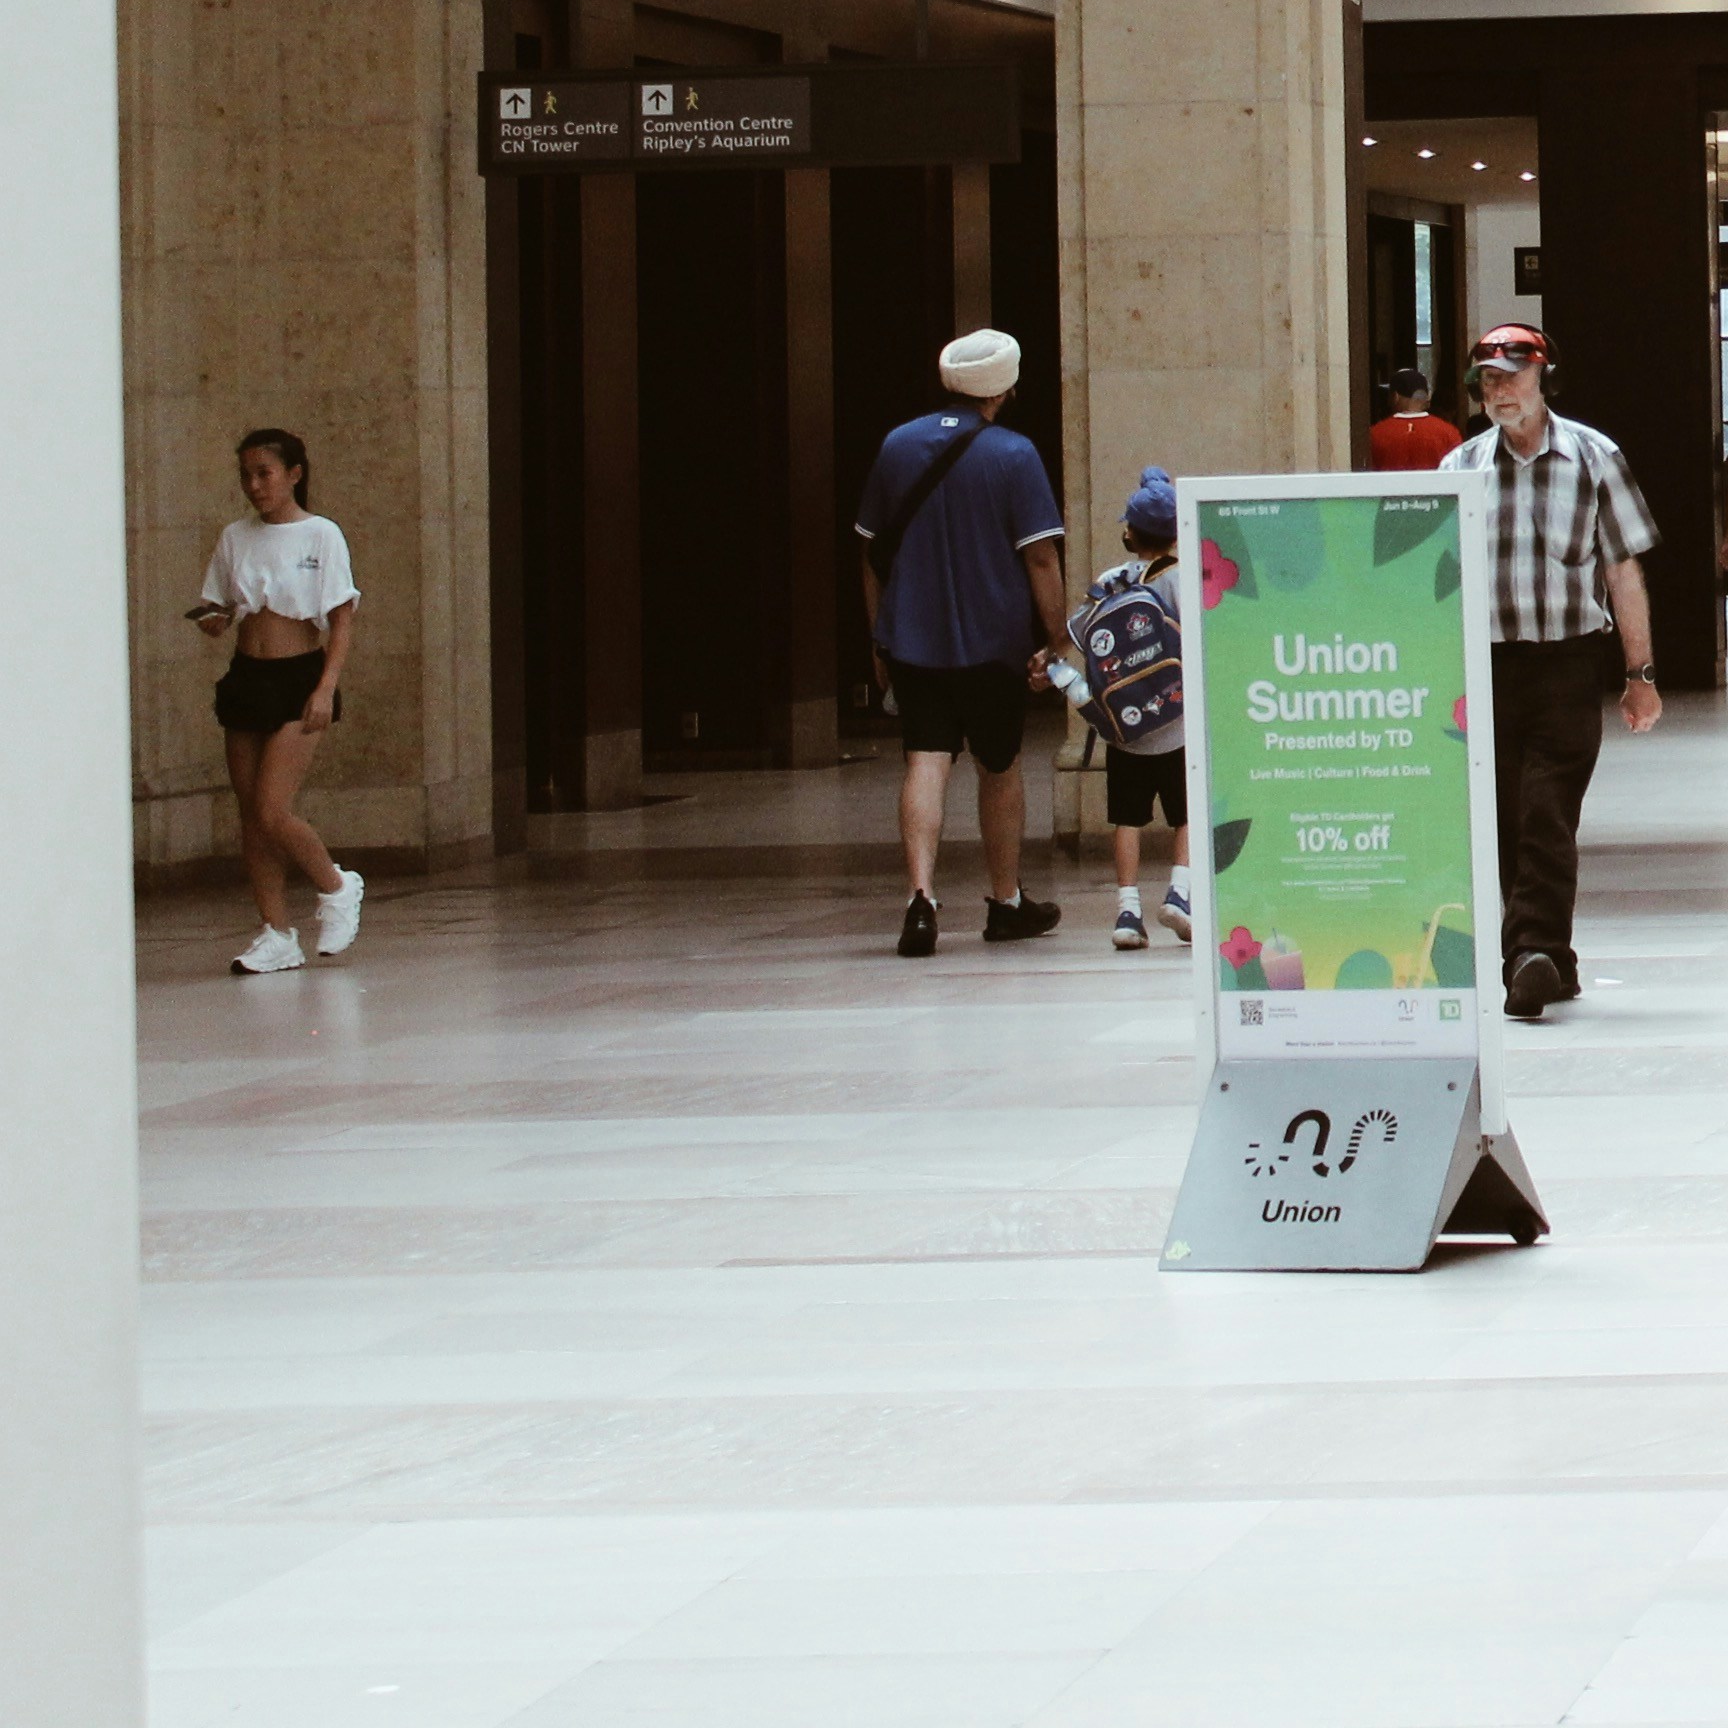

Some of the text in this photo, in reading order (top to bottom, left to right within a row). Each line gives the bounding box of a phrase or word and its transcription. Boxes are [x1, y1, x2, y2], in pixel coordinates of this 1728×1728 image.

[501, 119, 619, 139] Rogers Centre
[643, 115, 793, 134] Convention Centre
[501, 138, 580, 154] CN Tower
[643, 132, 791, 153] Ripley's Aquarium
[1383, 501, 1399, 511] Jun
[1273, 633, 1398, 676] Union
[1247, 680, 1430, 723] Summer
[1264, 729, 1413, 752] Presented by TD
[1250, 769, 1273, 780] Live
[1274, 768, 1306, 780] Music
[1314, 767, 1354, 779] Culture
[1363, 766, 1389, 777] Food
[1402, 764, 1432, 776] Drink
[1296, 825, 1391, 852] 10% off
[1261, 1199, 1342, 1223] Union
